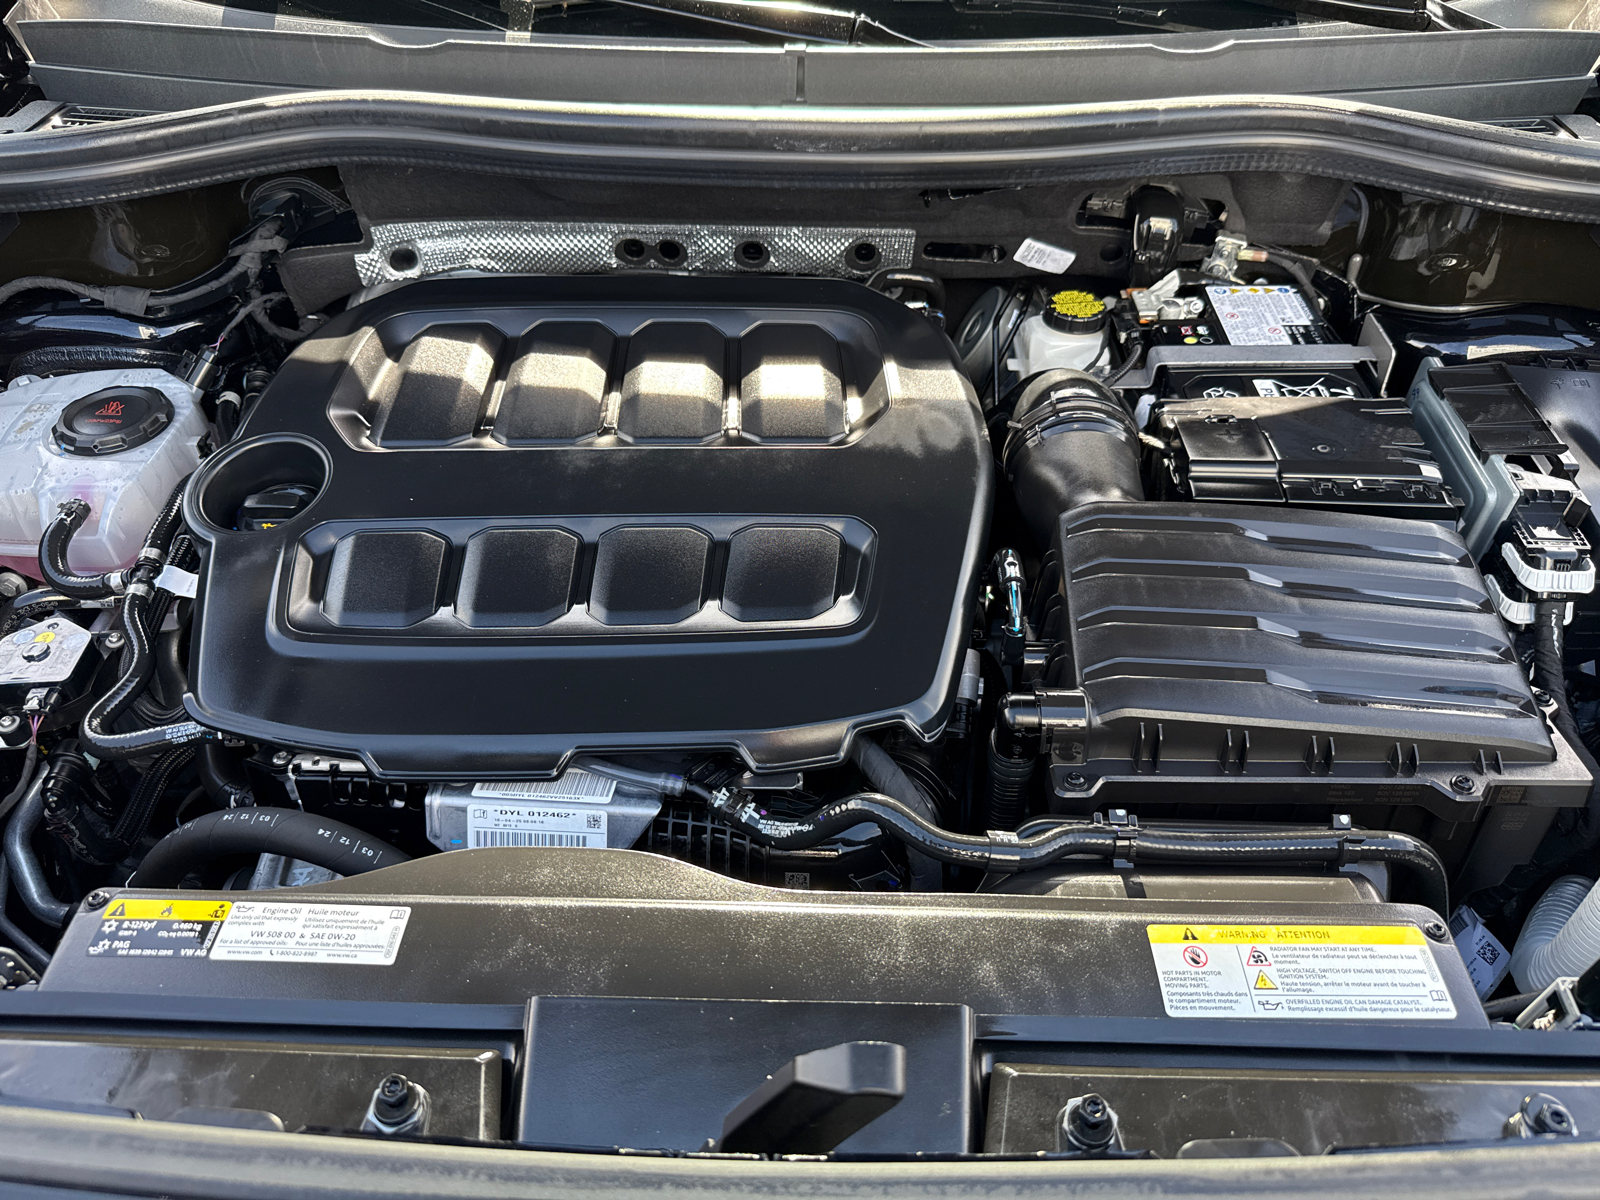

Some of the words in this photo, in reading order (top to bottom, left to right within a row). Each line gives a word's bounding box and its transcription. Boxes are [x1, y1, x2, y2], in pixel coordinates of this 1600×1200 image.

[262, 907, 289, 915] Engine
[193, 923, 203, 931] kg
[1277, 931, 1330, 939] ATTENTION
